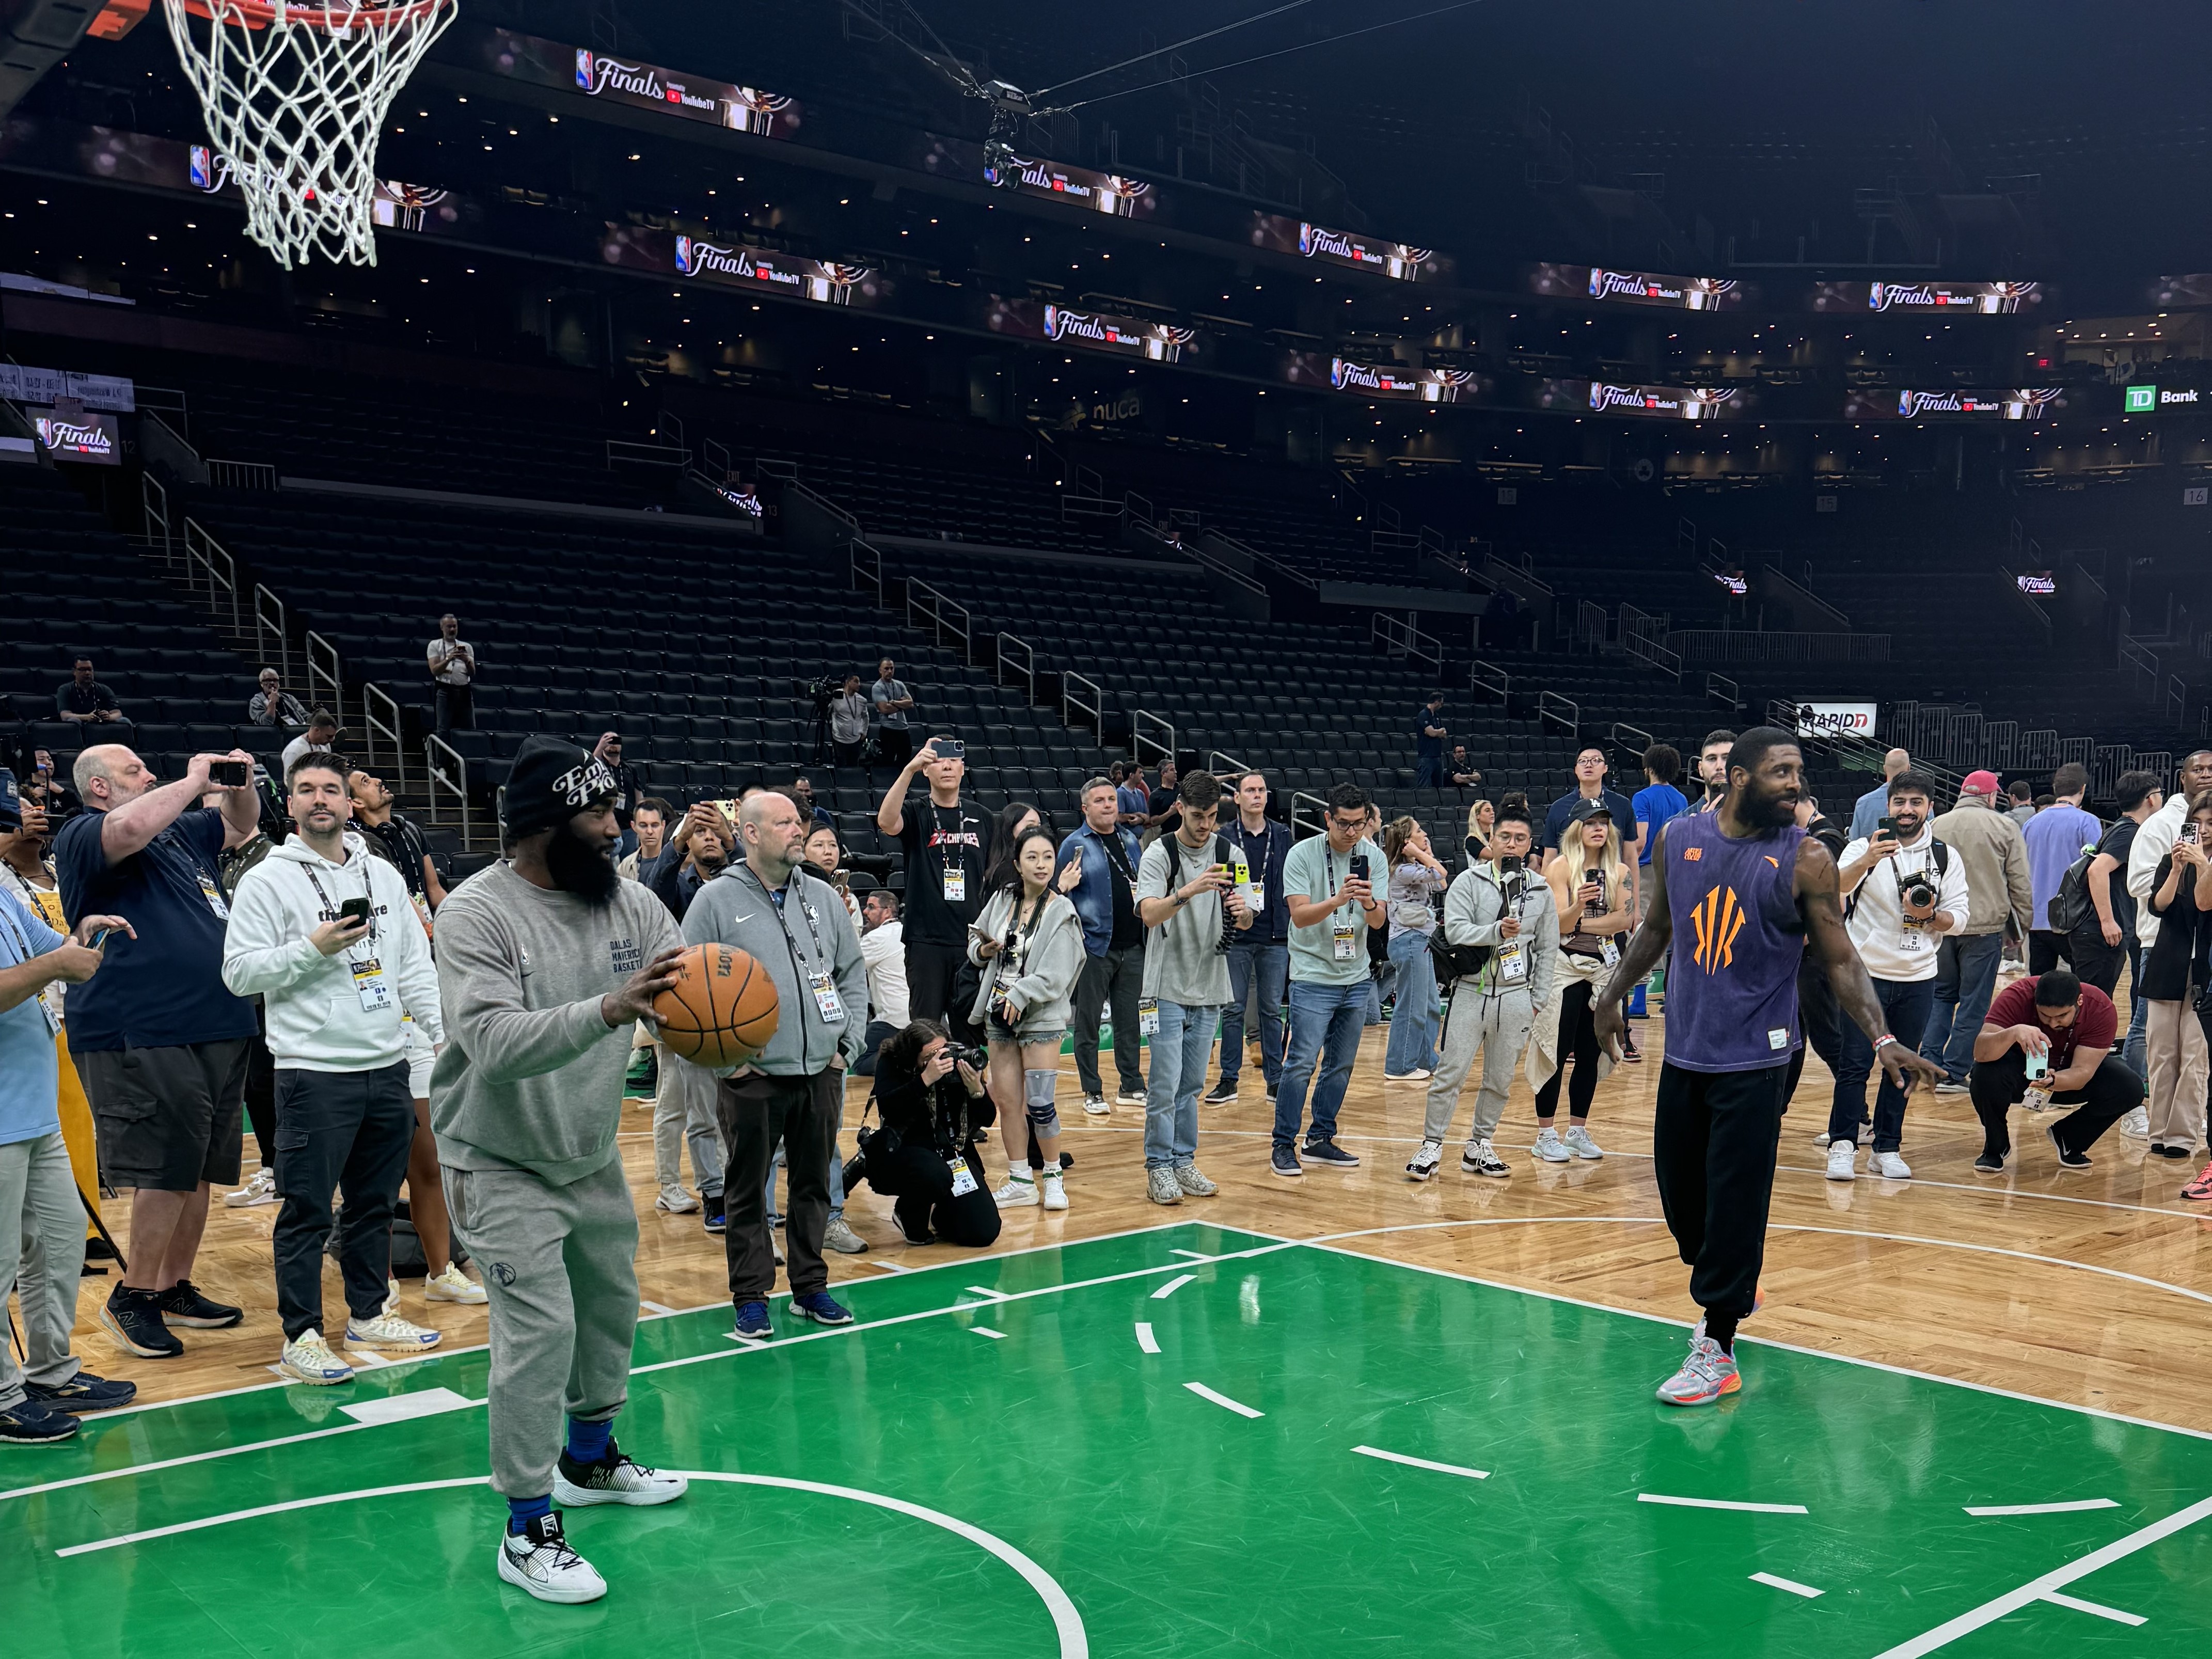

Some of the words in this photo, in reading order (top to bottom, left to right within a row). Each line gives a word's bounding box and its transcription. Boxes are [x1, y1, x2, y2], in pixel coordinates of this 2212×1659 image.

[586, 58, 665, 95] Finals
[1305, 228, 1353, 257] Finals
[685, 242, 755, 276] Finals
[1595, 272, 1648, 299] Finals
[1876, 285, 1935, 312] Finals
[1051, 310, 1105, 341] Finals
[1336, 362, 1380, 390] Finals
[1595, 386, 1646, 412] Finals
[1905, 392, 1962, 418] Finals
[2129, 390, 2152, 406] TD
[2161, 389, 2198, 403] Bank
[48, 422, 112, 449] Finals
[2190, 490, 2203, 502] 16
[767, 504, 778, 516] 13
[2024, 577, 2056, 592] Finals
